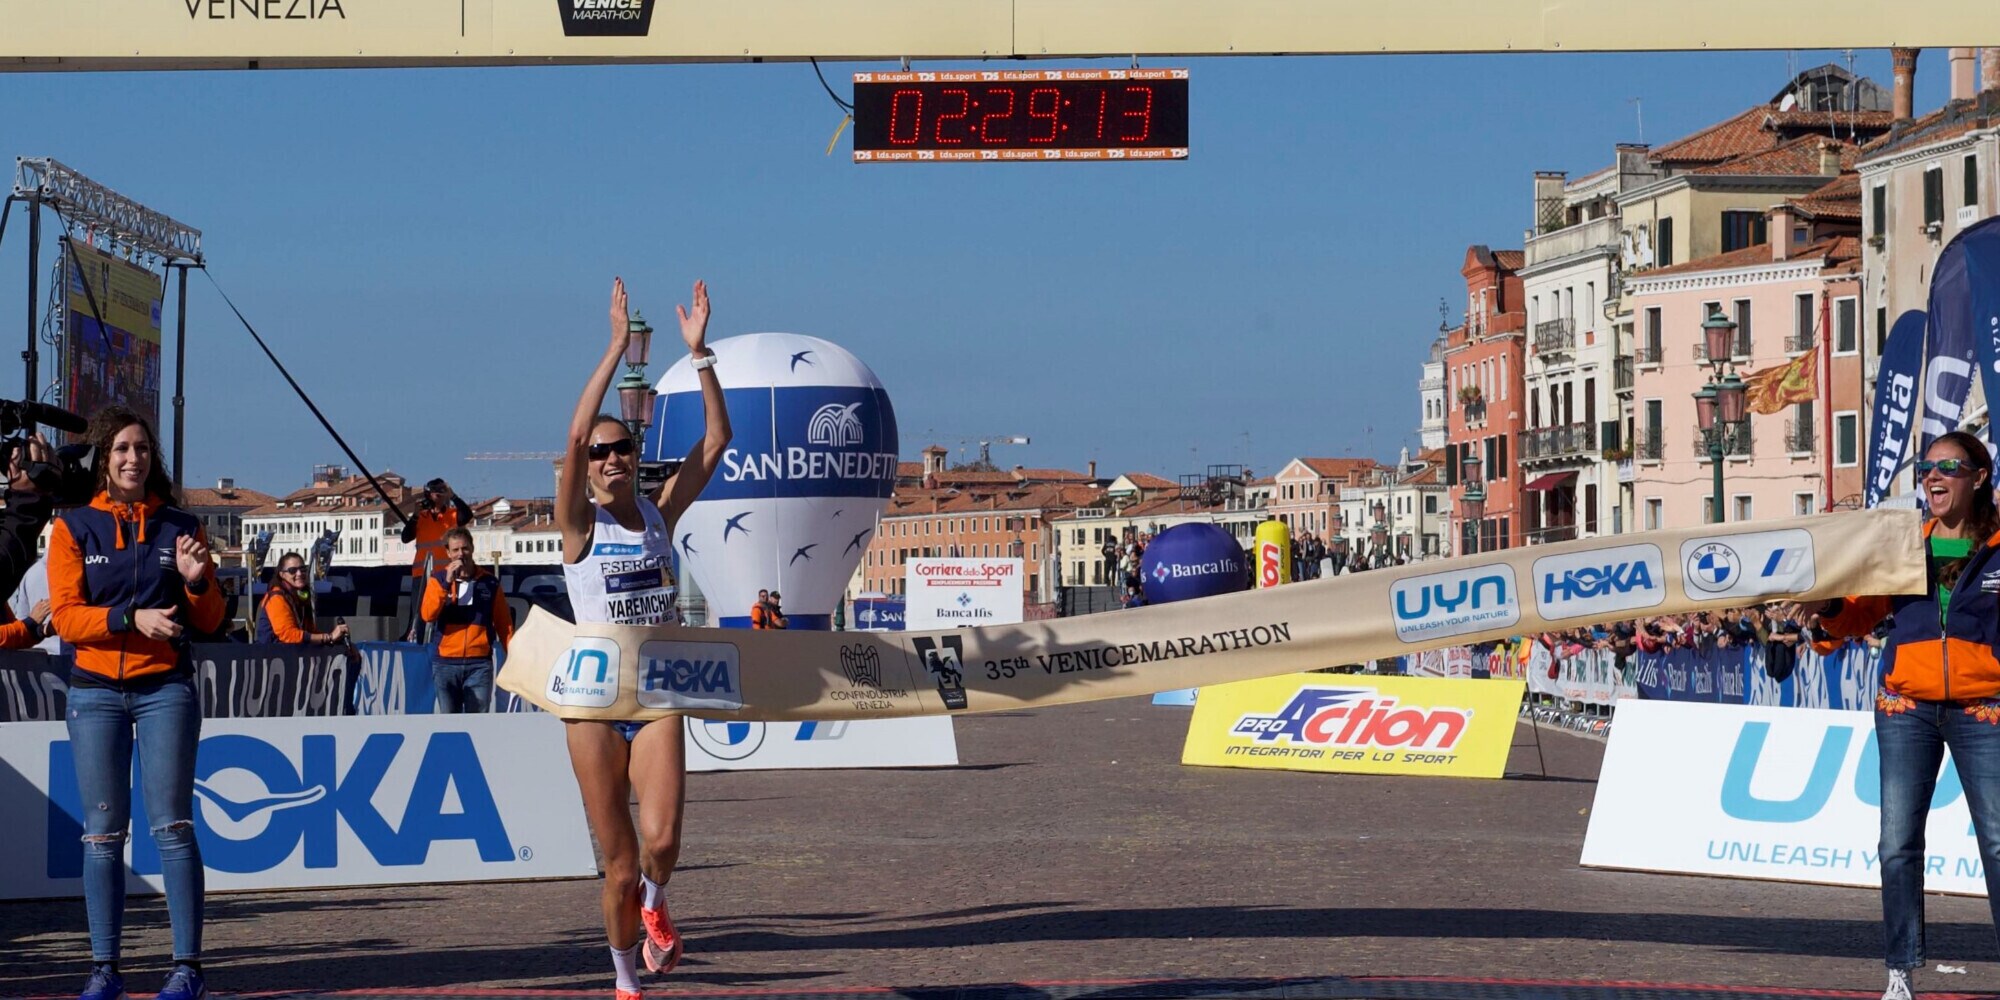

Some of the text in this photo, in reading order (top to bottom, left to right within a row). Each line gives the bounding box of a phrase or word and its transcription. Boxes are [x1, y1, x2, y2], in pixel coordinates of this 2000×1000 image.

[185, 0, 345, 19] VENEZIA
[573, 10, 641, 20] MARATHON
[878, 73, 913, 82] tds.sport
[941, 72, 976, 81] tds.sport
[1003, 71, 1039, 80] tds.sport
[1067, 71, 1101, 80] tds.sport
[1130, 70, 1165, 79] tds.sport
[889, 87, 1152, 144] 02:29:13
[877, 151, 912, 160] tds.sport
[940, 151, 975, 159] tds.sport
[1003, 150, 1038, 159] tds.sport
[1065, 150, 1101, 158] tds.sport
[1130, 149, 1165, 158] tds.sport
[1873, 373, 1913, 502] aria
[723, 448, 783, 482] SAN
[915, 563, 962, 576] Corriere
[981, 563, 1014, 580] Sport
[1172, 558, 1239, 578] Banca Ifis
[1544, 561, 1653, 604] HOKA
[881, 610, 901, 622] SAN
[937, 608, 993, 618] Banca Ifis
[1400, 609, 1510, 634] UNLEASH YOUR NATURE
[984, 622, 1292, 681] 35th VENICEMARATHON
[645, 659, 732, 693] HOKA
[830, 688, 909, 701] CONFINDUSTRIA
[852, 701, 895, 711] VENEZIA
[1237, 718, 1288, 734] PRO
[1258, 688, 1466, 749] Action
[1225, 745, 1458, 765] INTEGRATORI PER LO SPORT
[1707, 840, 1852, 868] UNLEASH
[1861, 851, 1946, 875] YR
